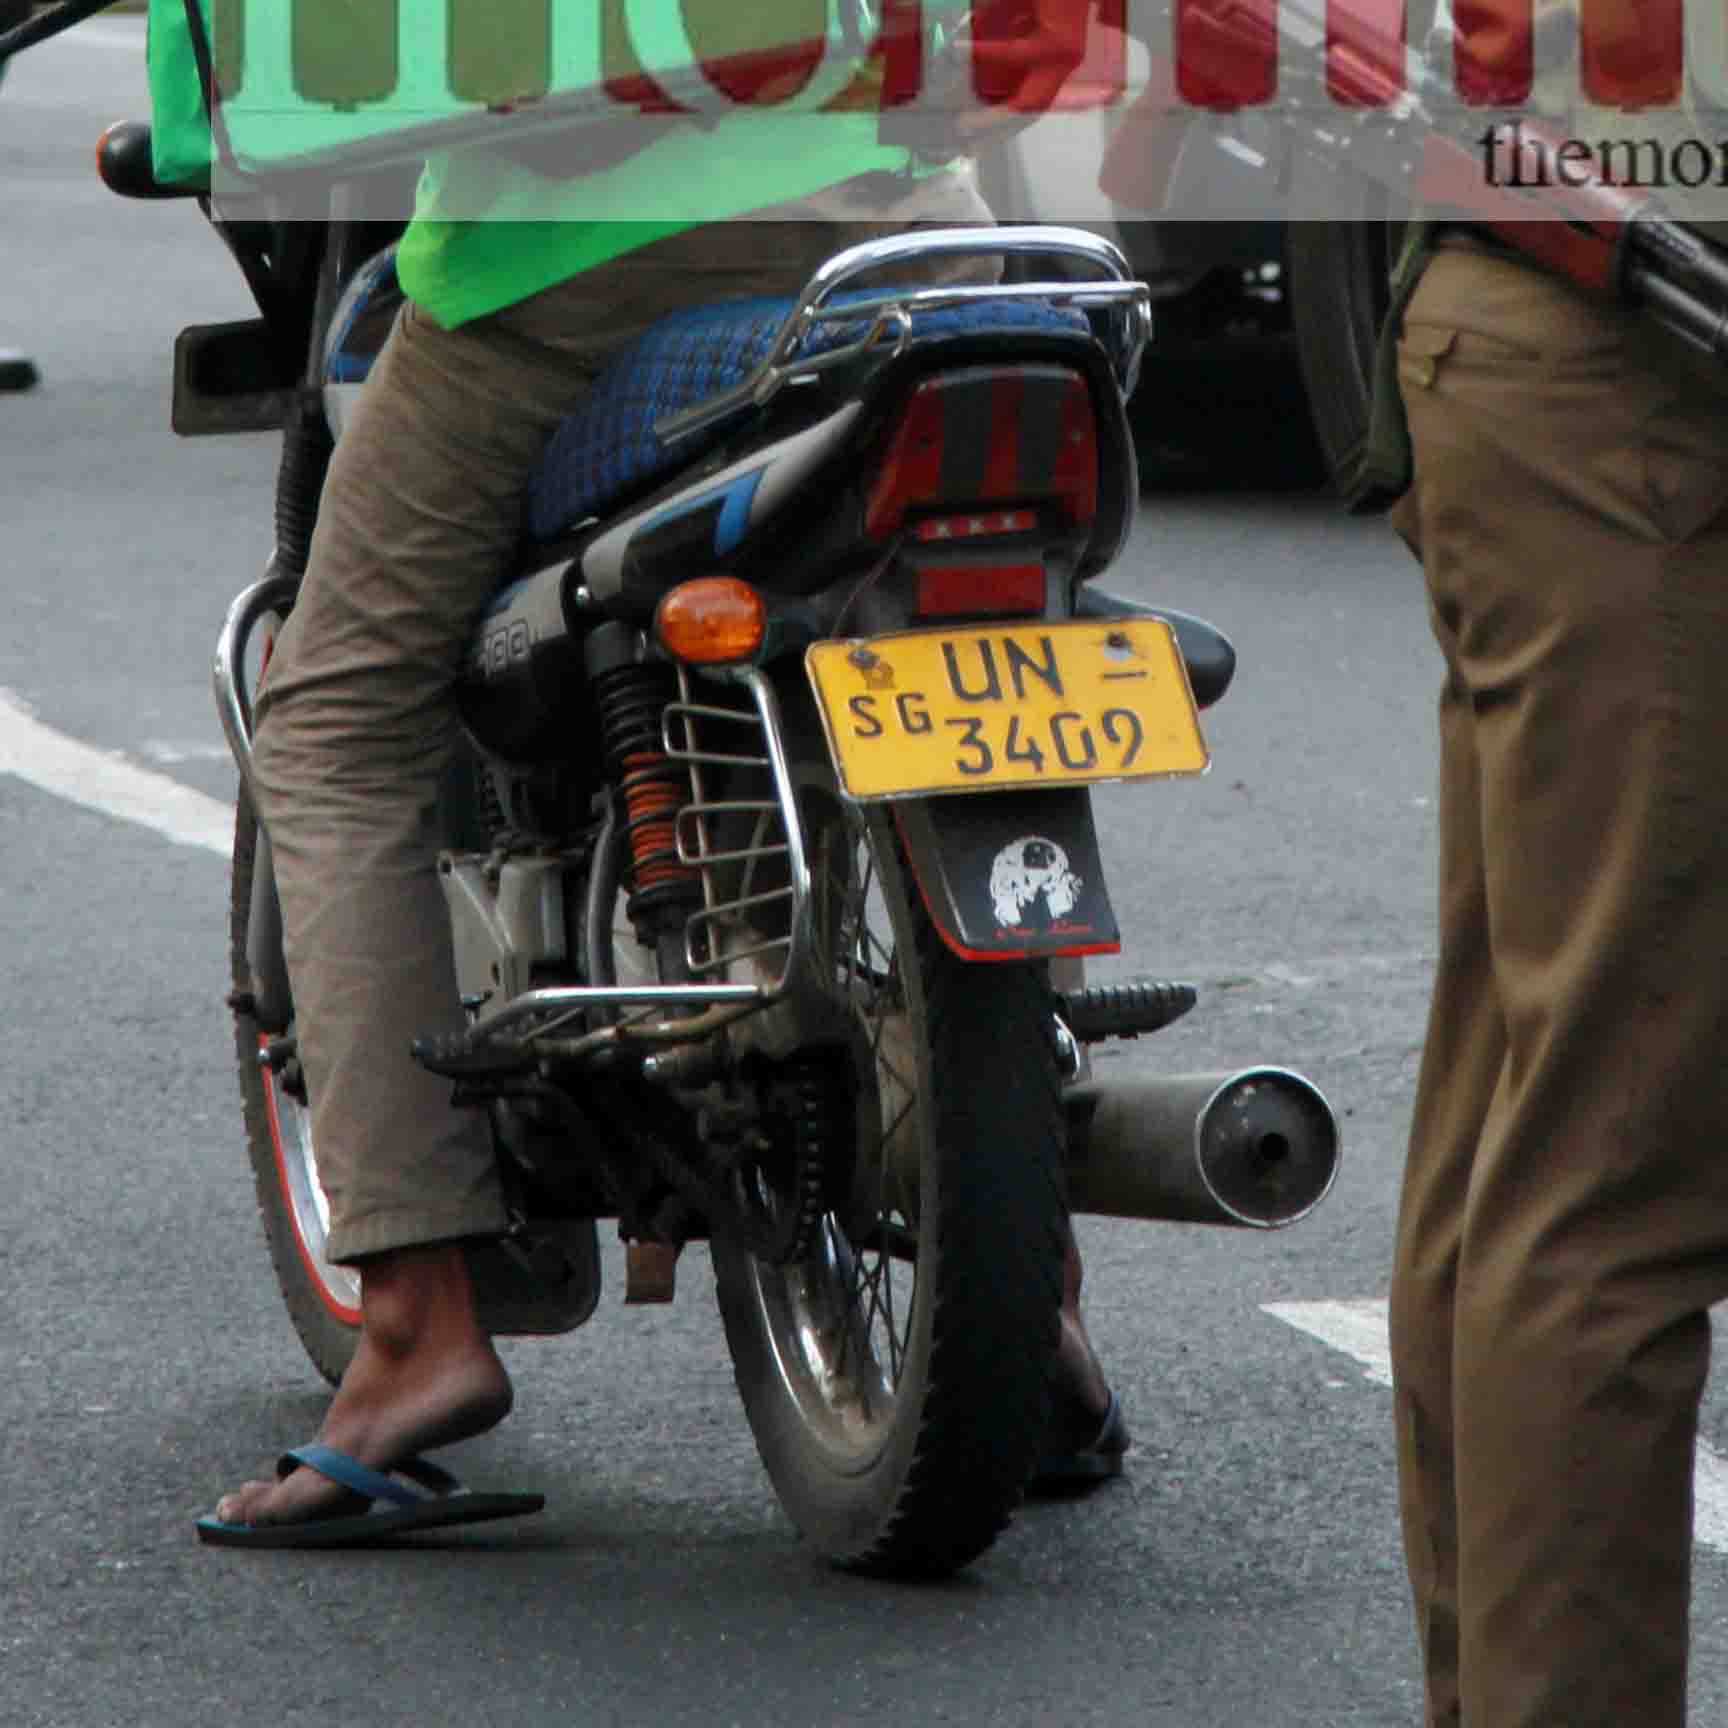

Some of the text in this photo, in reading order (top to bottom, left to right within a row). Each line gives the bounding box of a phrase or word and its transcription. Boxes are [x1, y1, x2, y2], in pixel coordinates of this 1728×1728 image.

[941, 636, 1065, 703] UN
[847, 692, 934, 739] SG
[944, 707, 1145, 776] 3409
